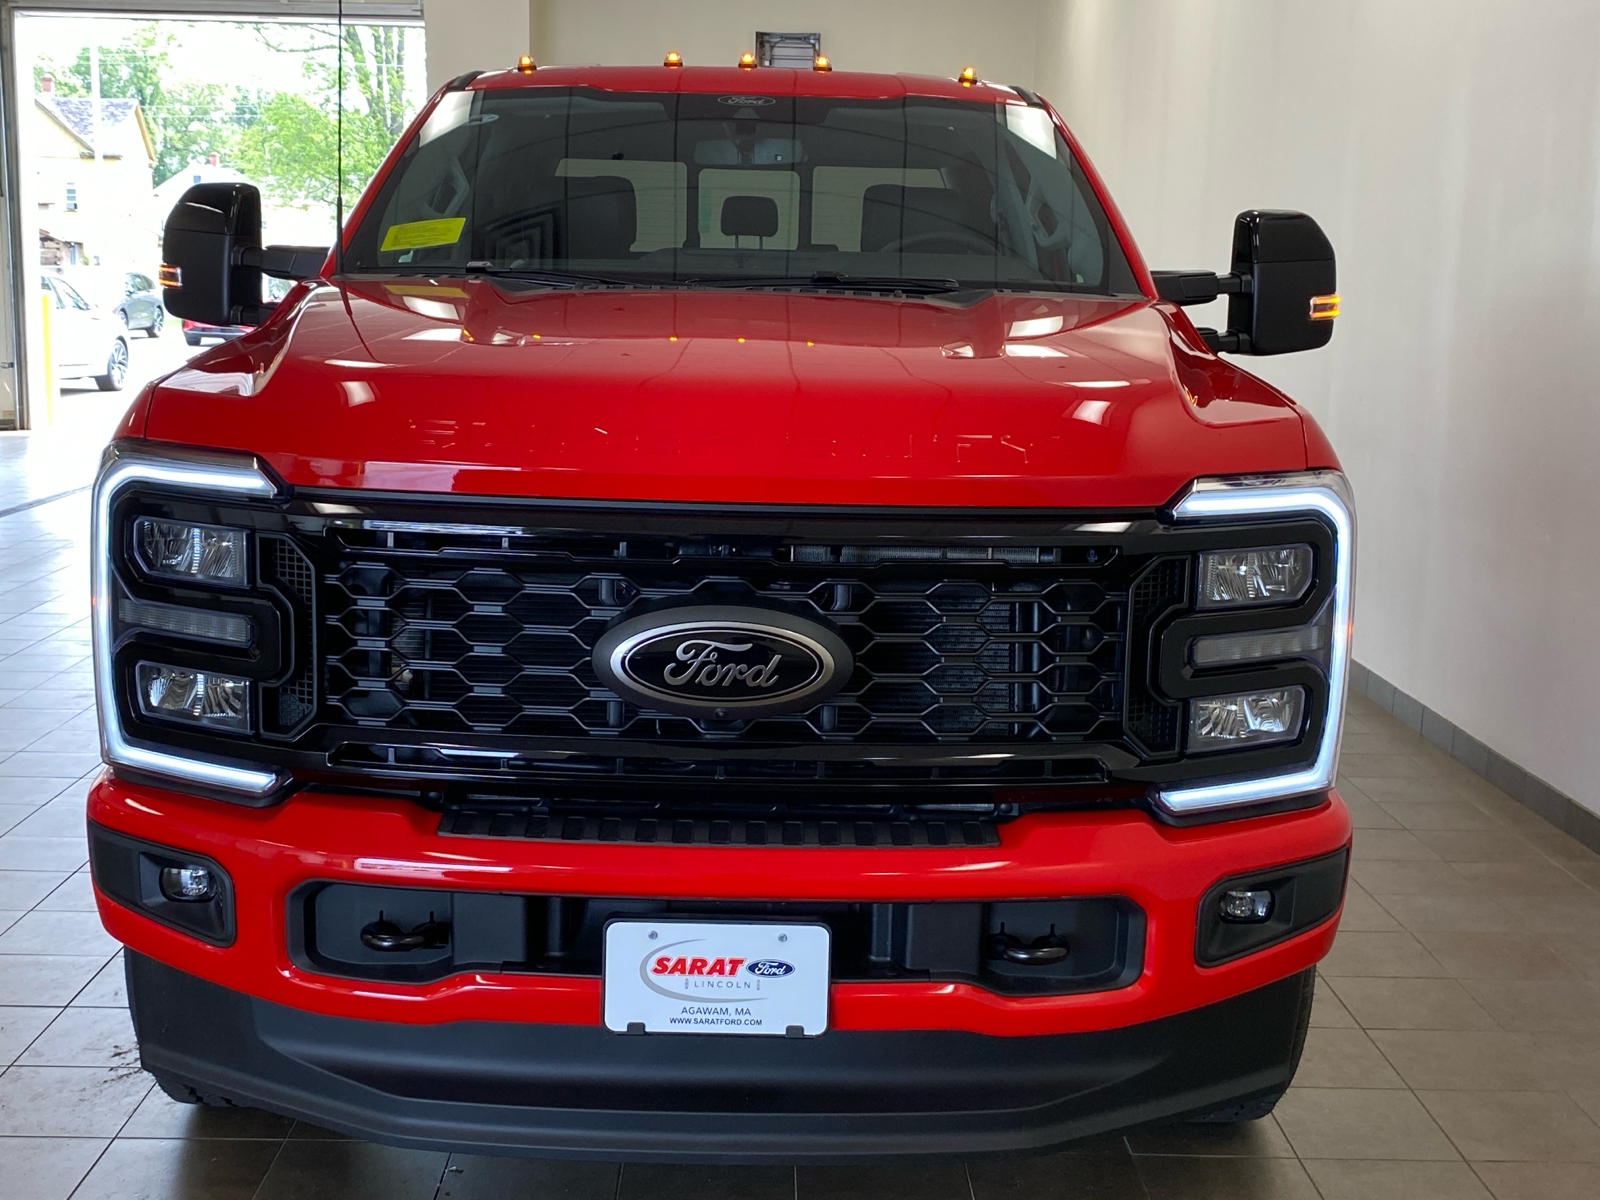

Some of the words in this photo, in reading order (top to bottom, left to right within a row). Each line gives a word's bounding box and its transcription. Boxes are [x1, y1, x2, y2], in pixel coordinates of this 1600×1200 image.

[727, 96, 766, 105] Ford
[663, 639, 782, 687] Ford
[651, 955, 746, 977] SARAT
[753, 960, 787, 975] Ford
[694, 980, 751, 989] LINCOLN
[680, 1006, 732, 1017] AGAWAM,
[734, 1007, 752, 1016] MA
[669, 1017, 763, 1026] WWW.SARATFORD.COM
